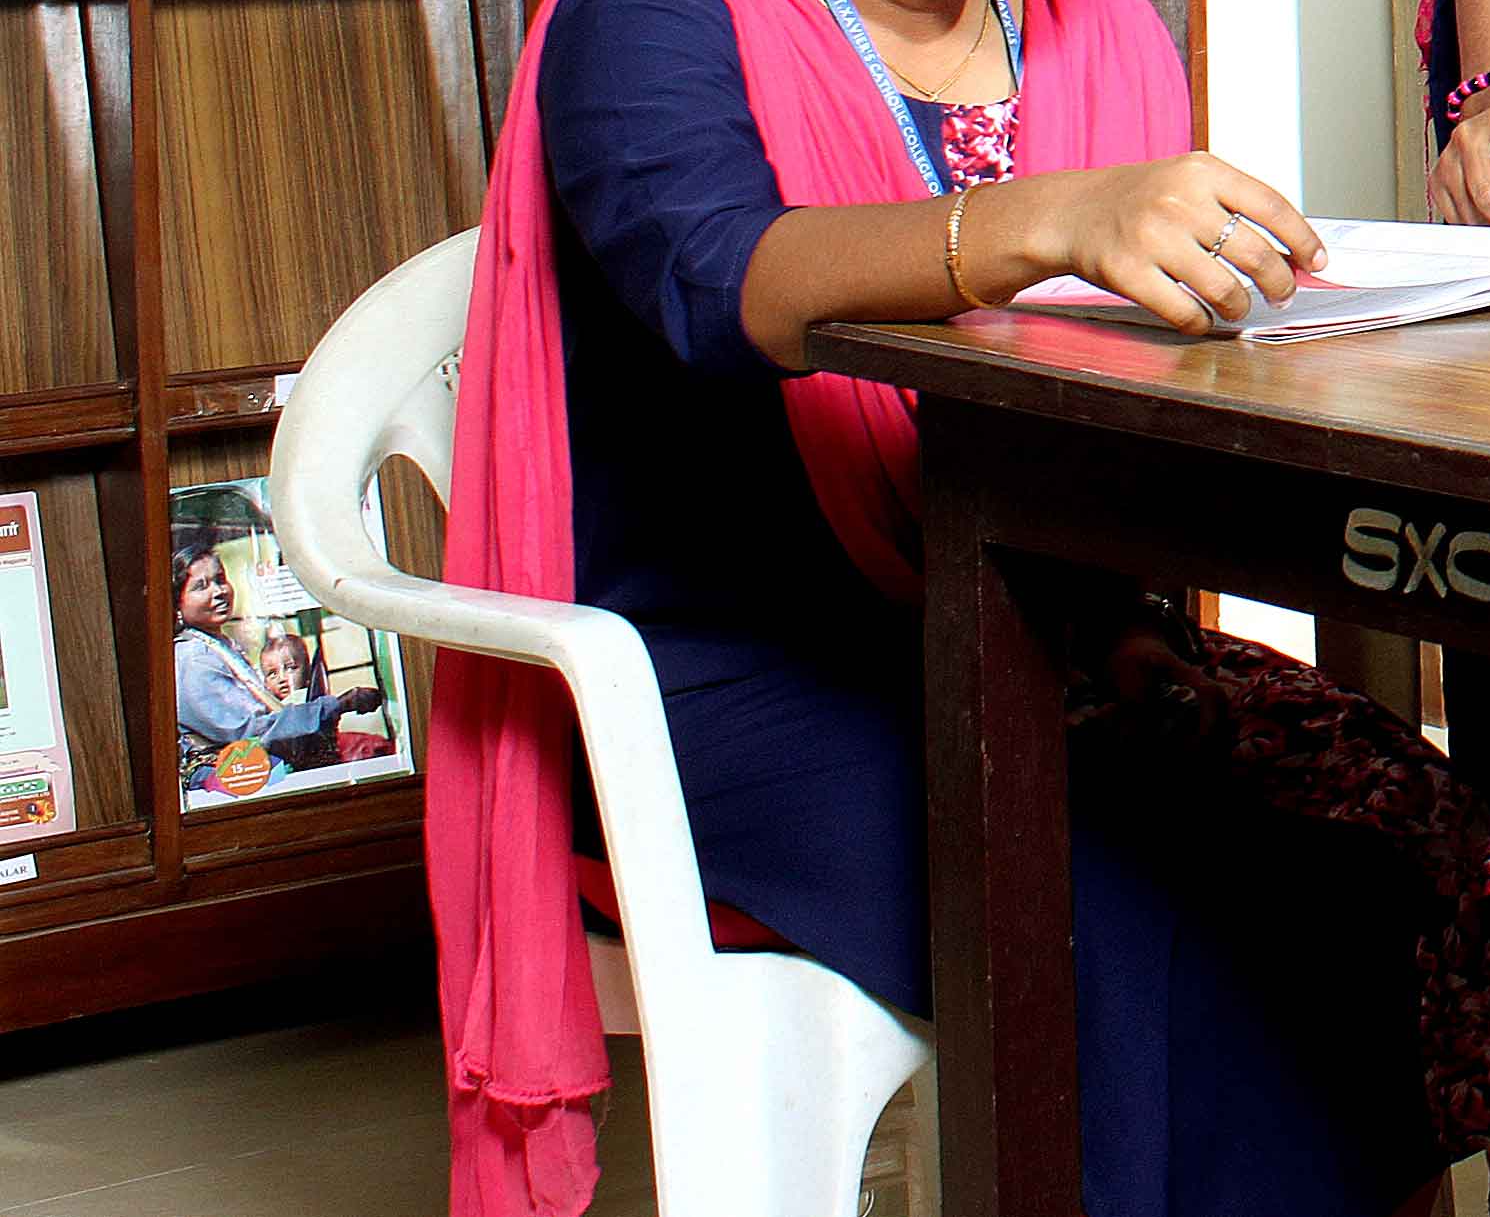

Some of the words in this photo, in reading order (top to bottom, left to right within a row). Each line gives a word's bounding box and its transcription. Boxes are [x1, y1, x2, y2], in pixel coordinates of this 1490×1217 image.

[869, 59, 907, 126] CATHOLIC
[902, 124, 935, 183] COLLEGE
[231, 762, 243, 775] 15
